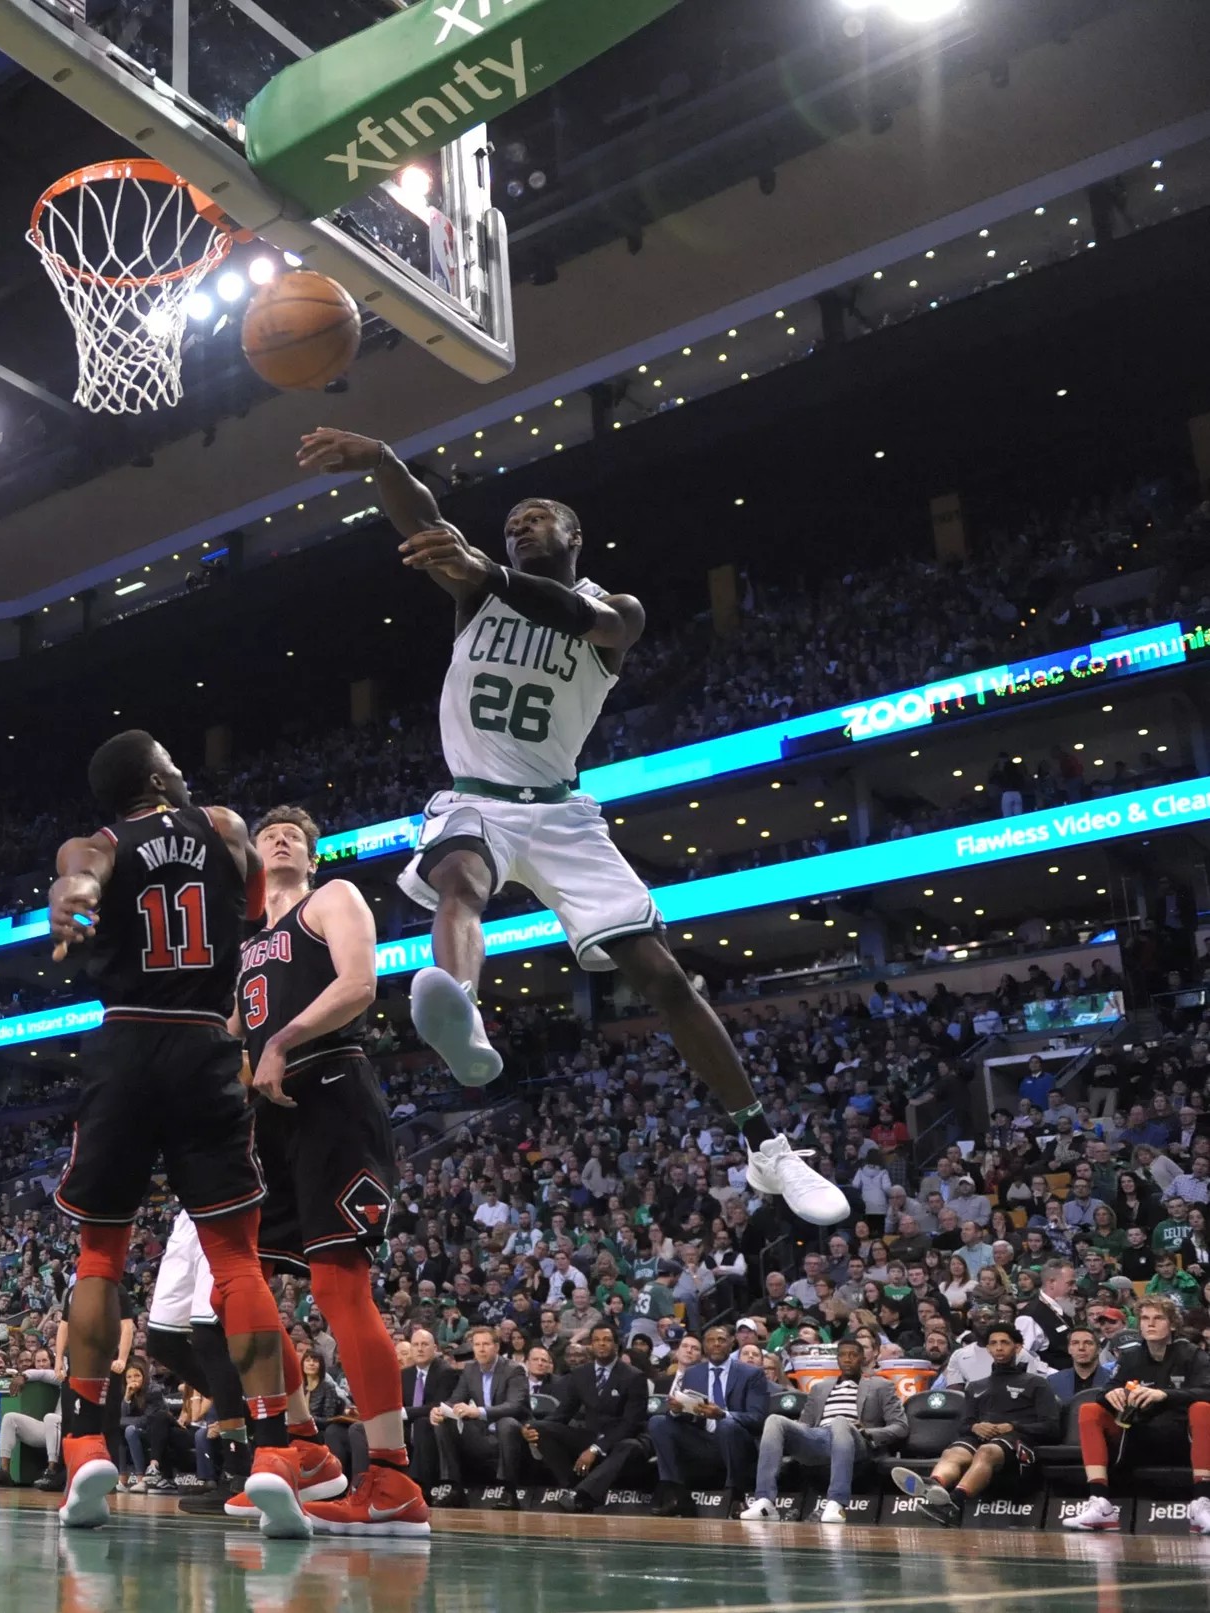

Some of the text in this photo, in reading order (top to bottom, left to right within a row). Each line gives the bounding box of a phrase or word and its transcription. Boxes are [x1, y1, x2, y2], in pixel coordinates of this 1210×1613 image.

[324, 37, 527, 182] xfinity
[469, 616, 583, 682] CELTICS
[469, 672, 555, 743] 26
[842, 682, 966, 738] zoom
[992, 664, 1065, 697] Video
[136, 835, 207, 872] NWABA
[956, 818, 1049, 856] Flawless
[1053, 805, 1122, 838] Video
[1127, 802, 1148, 823] &
[137, 881, 215, 972] 11
[16, 1023, 25, 1035] &
[27, 1016, 62, 1034] Instant
[243, 974, 269, 1030] 3
[898, 1378, 916, 1397] G
[691, 1492, 722, 1506] Blue
[974, 1500, 1033, 1516] jetBlue
[1149, 1503, 1190, 1521] jetBl
